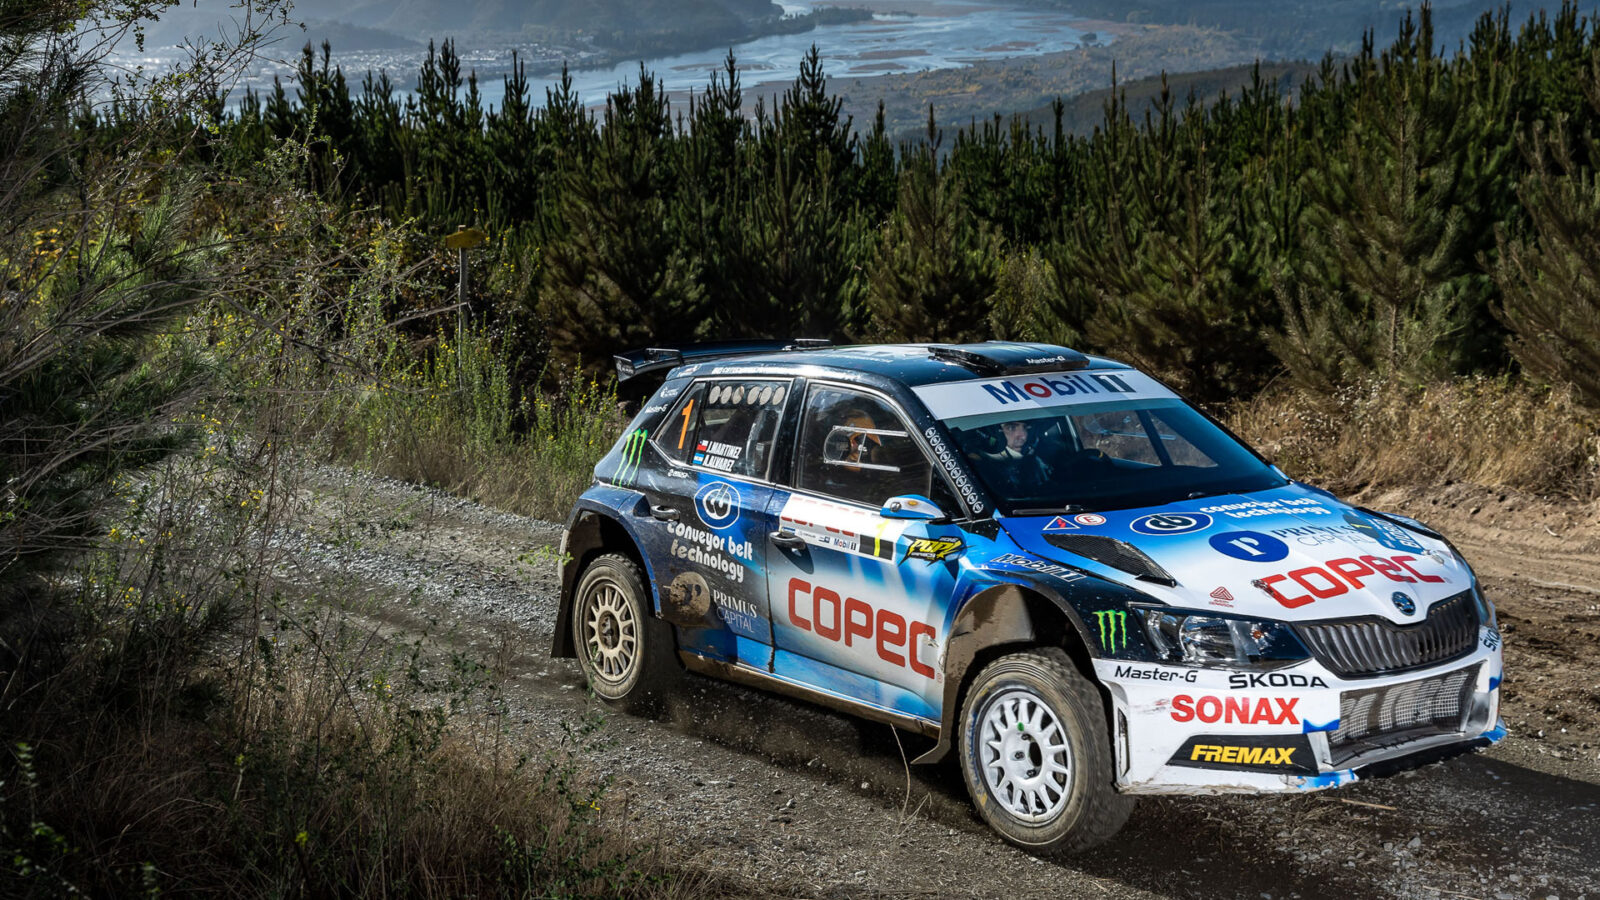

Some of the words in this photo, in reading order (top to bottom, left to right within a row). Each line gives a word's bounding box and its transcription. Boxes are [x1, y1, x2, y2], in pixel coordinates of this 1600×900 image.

[981, 374, 1100, 405] Mobil
[677, 399, 694, 450] 1
[1200, 501, 1284, 514] conveyor
[1278, 497, 1322, 506] belt
[1224, 506, 1332, 519] technology
[667, 519, 725, 552] conveyor
[727, 535, 753, 561] belt
[671, 538, 744, 583] technology
[1255, 555, 1446, 609] COPEC
[713, 589, 757, 618] PRIMUS
[716, 607, 755, 633] CAPITAL
[788, 577, 936, 680] COPEC
[1114, 665, 1199, 683] Master-G
[1229, 671, 1330, 689] ŠKODA
[1170, 694, 1300, 725] SONAX
[1190, 744, 1297, 765] FREMAX
